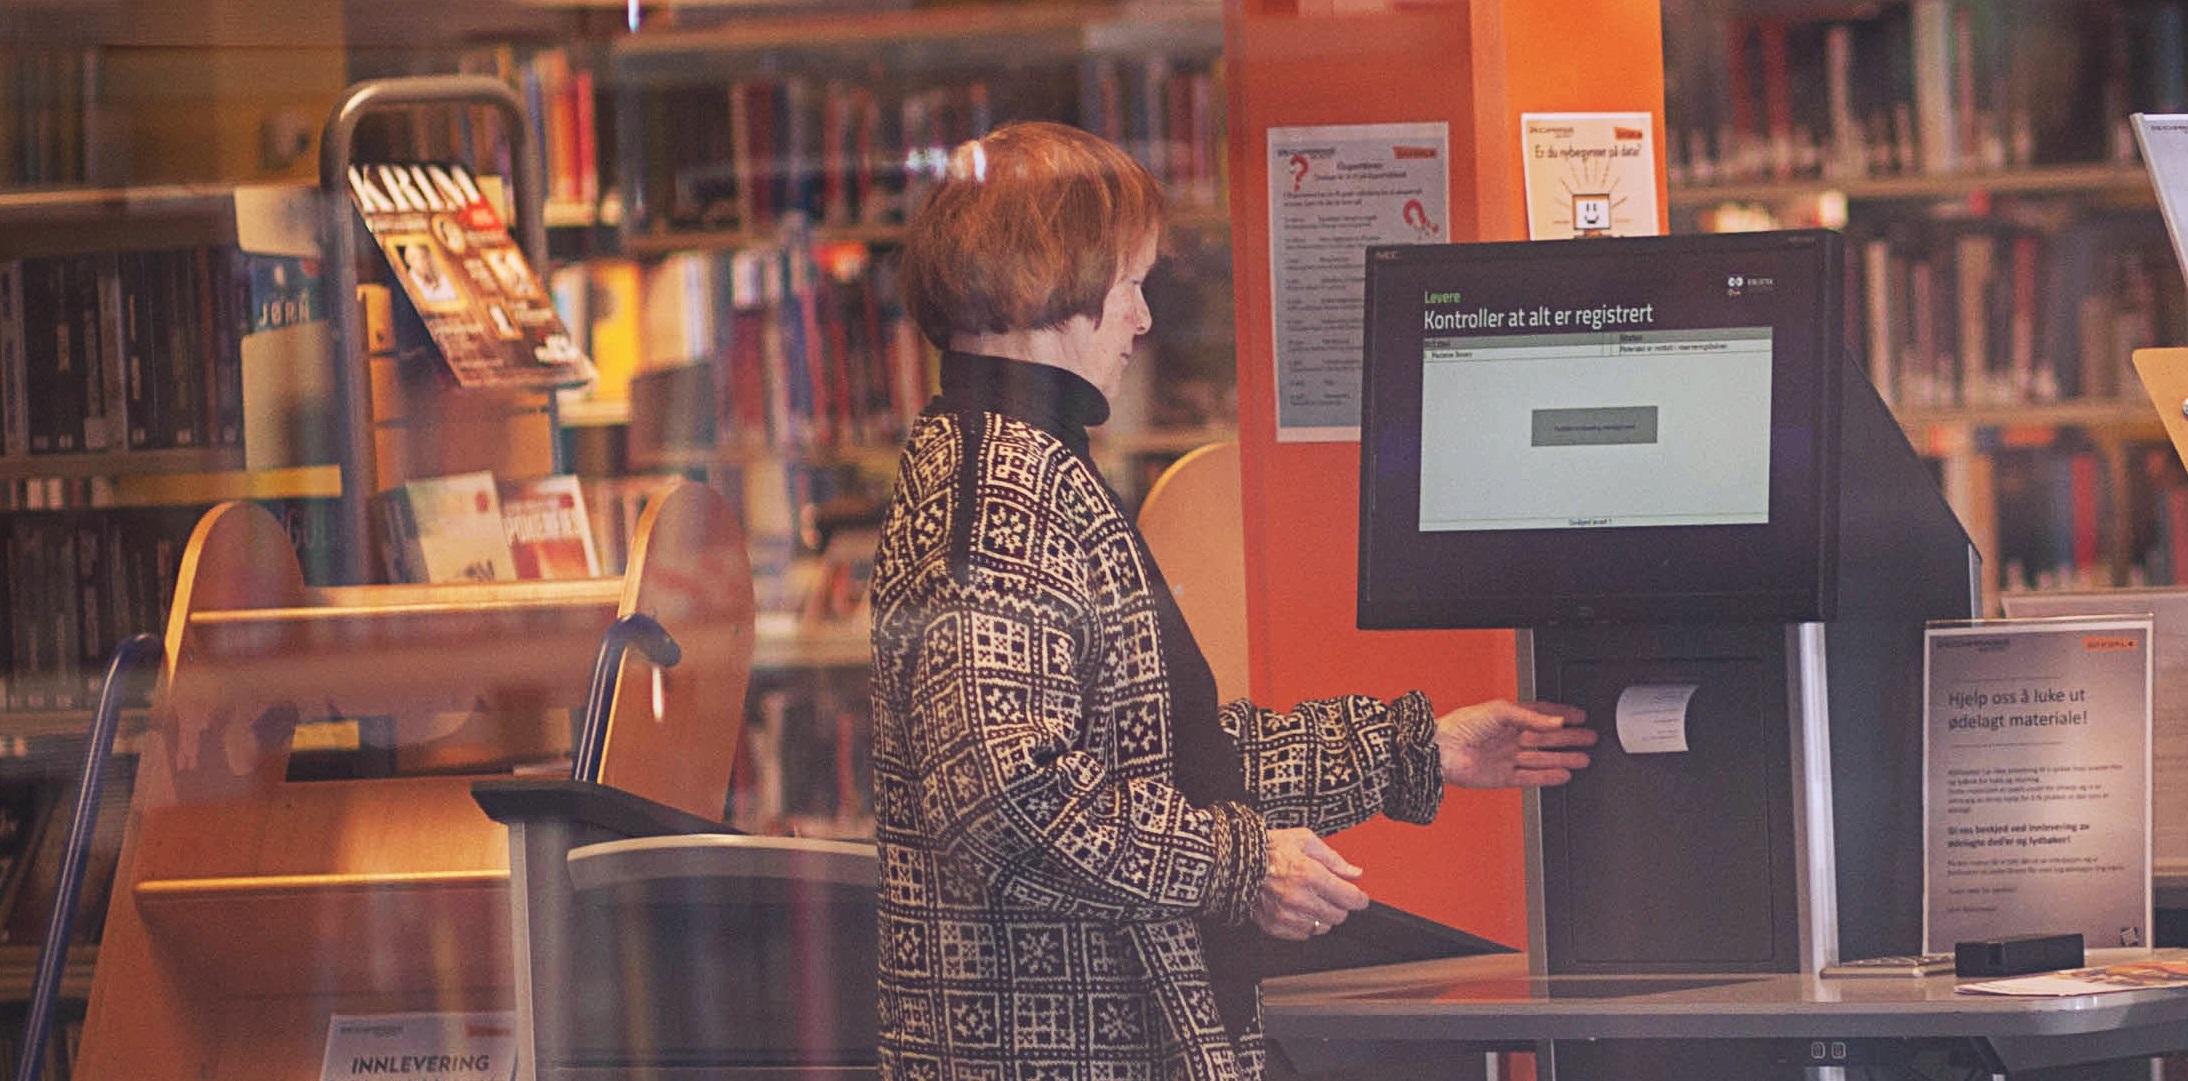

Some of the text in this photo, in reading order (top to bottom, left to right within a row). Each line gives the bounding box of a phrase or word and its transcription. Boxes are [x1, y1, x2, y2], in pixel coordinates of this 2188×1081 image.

[347, 164, 481, 213] KRIM
[1424, 291, 1462, 304] Levere
[1424, 303, 1654, 330] Kontroller at alt er registrert
[1948, 688, 2085, 708] Hjelp oss å luke ut
[1948, 710, 2088, 731] ødelagt materiale!
[351, 1054, 491, 1075] INNLEVERING
